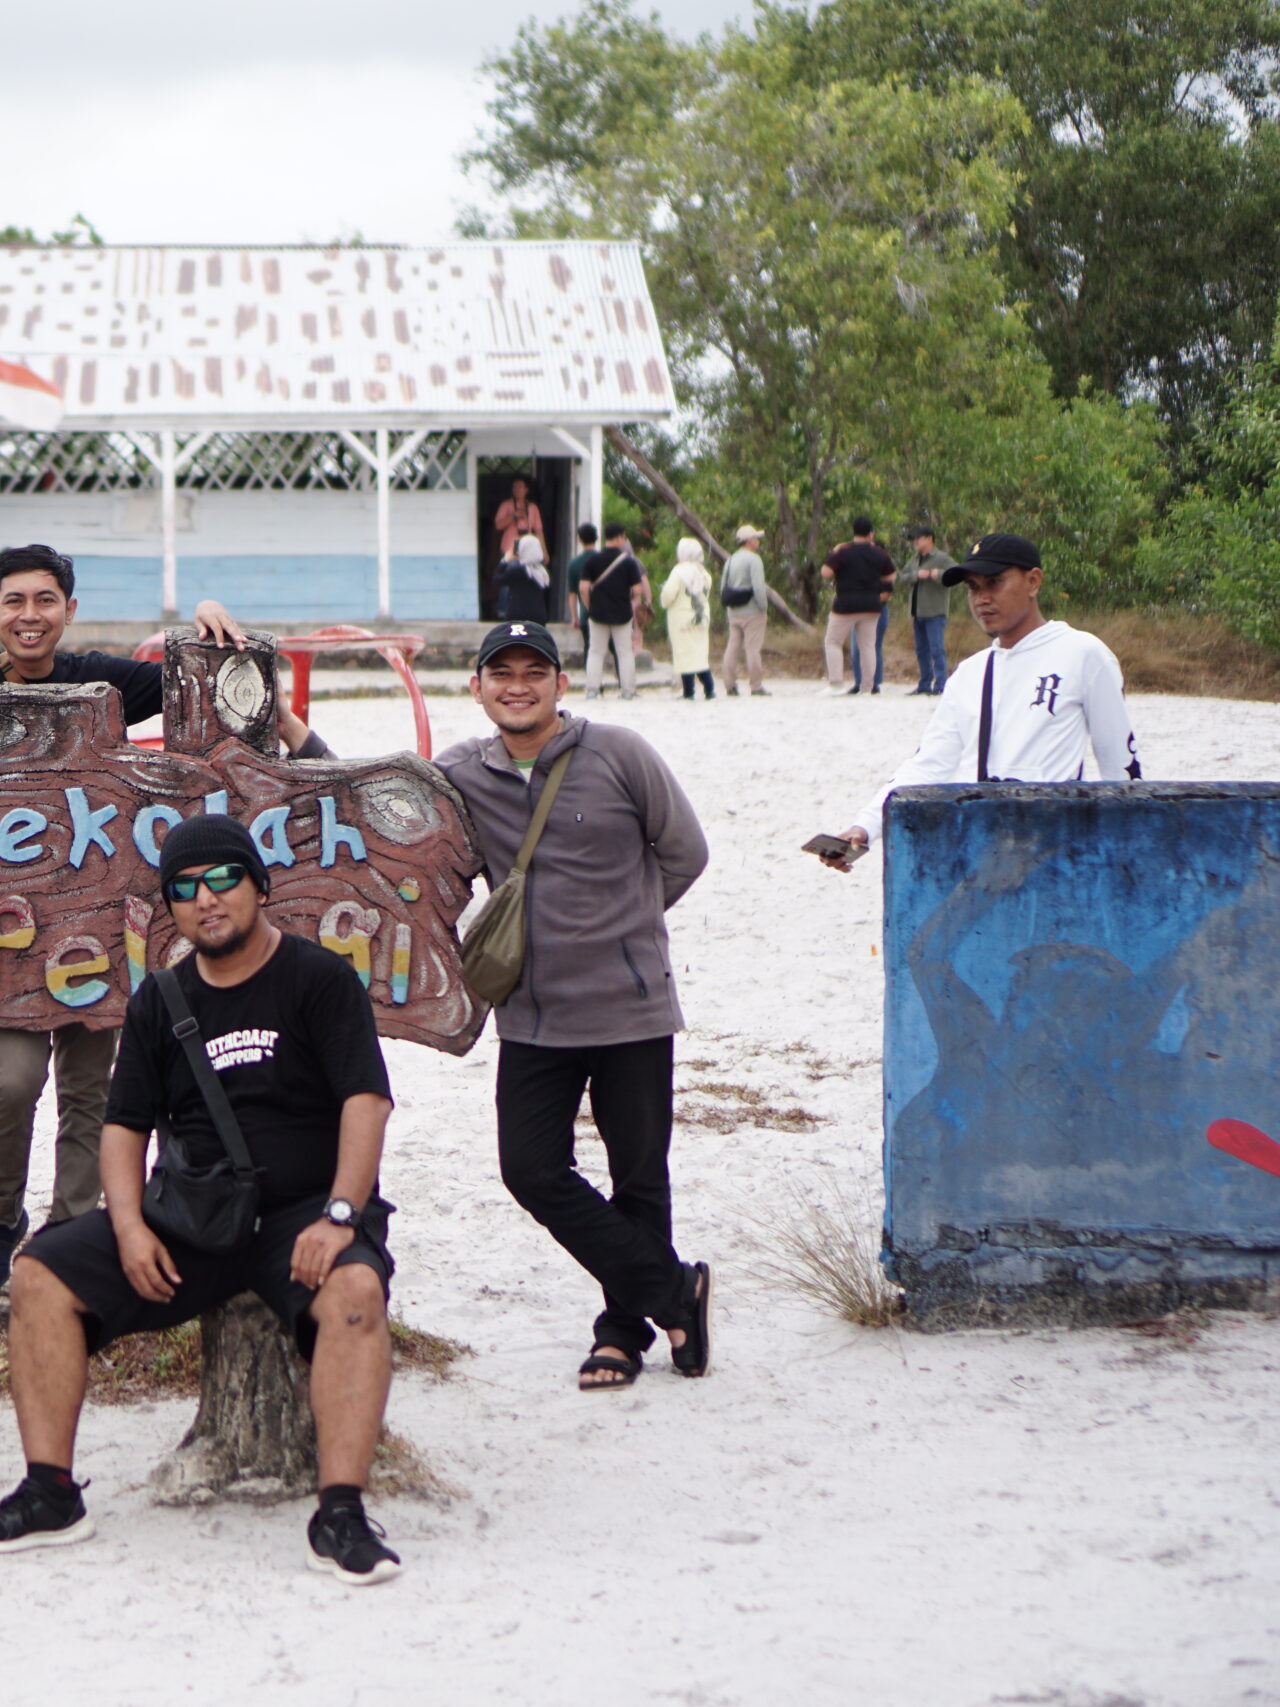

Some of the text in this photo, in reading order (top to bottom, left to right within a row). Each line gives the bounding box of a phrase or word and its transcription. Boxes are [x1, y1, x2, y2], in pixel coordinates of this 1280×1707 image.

[510, 624, 528, 636] R
[1029, 673, 1064, 717] R
[205, 1028, 279, 1058] UTHCOAST
[211, 1048, 263, 1071] HOPPERS
